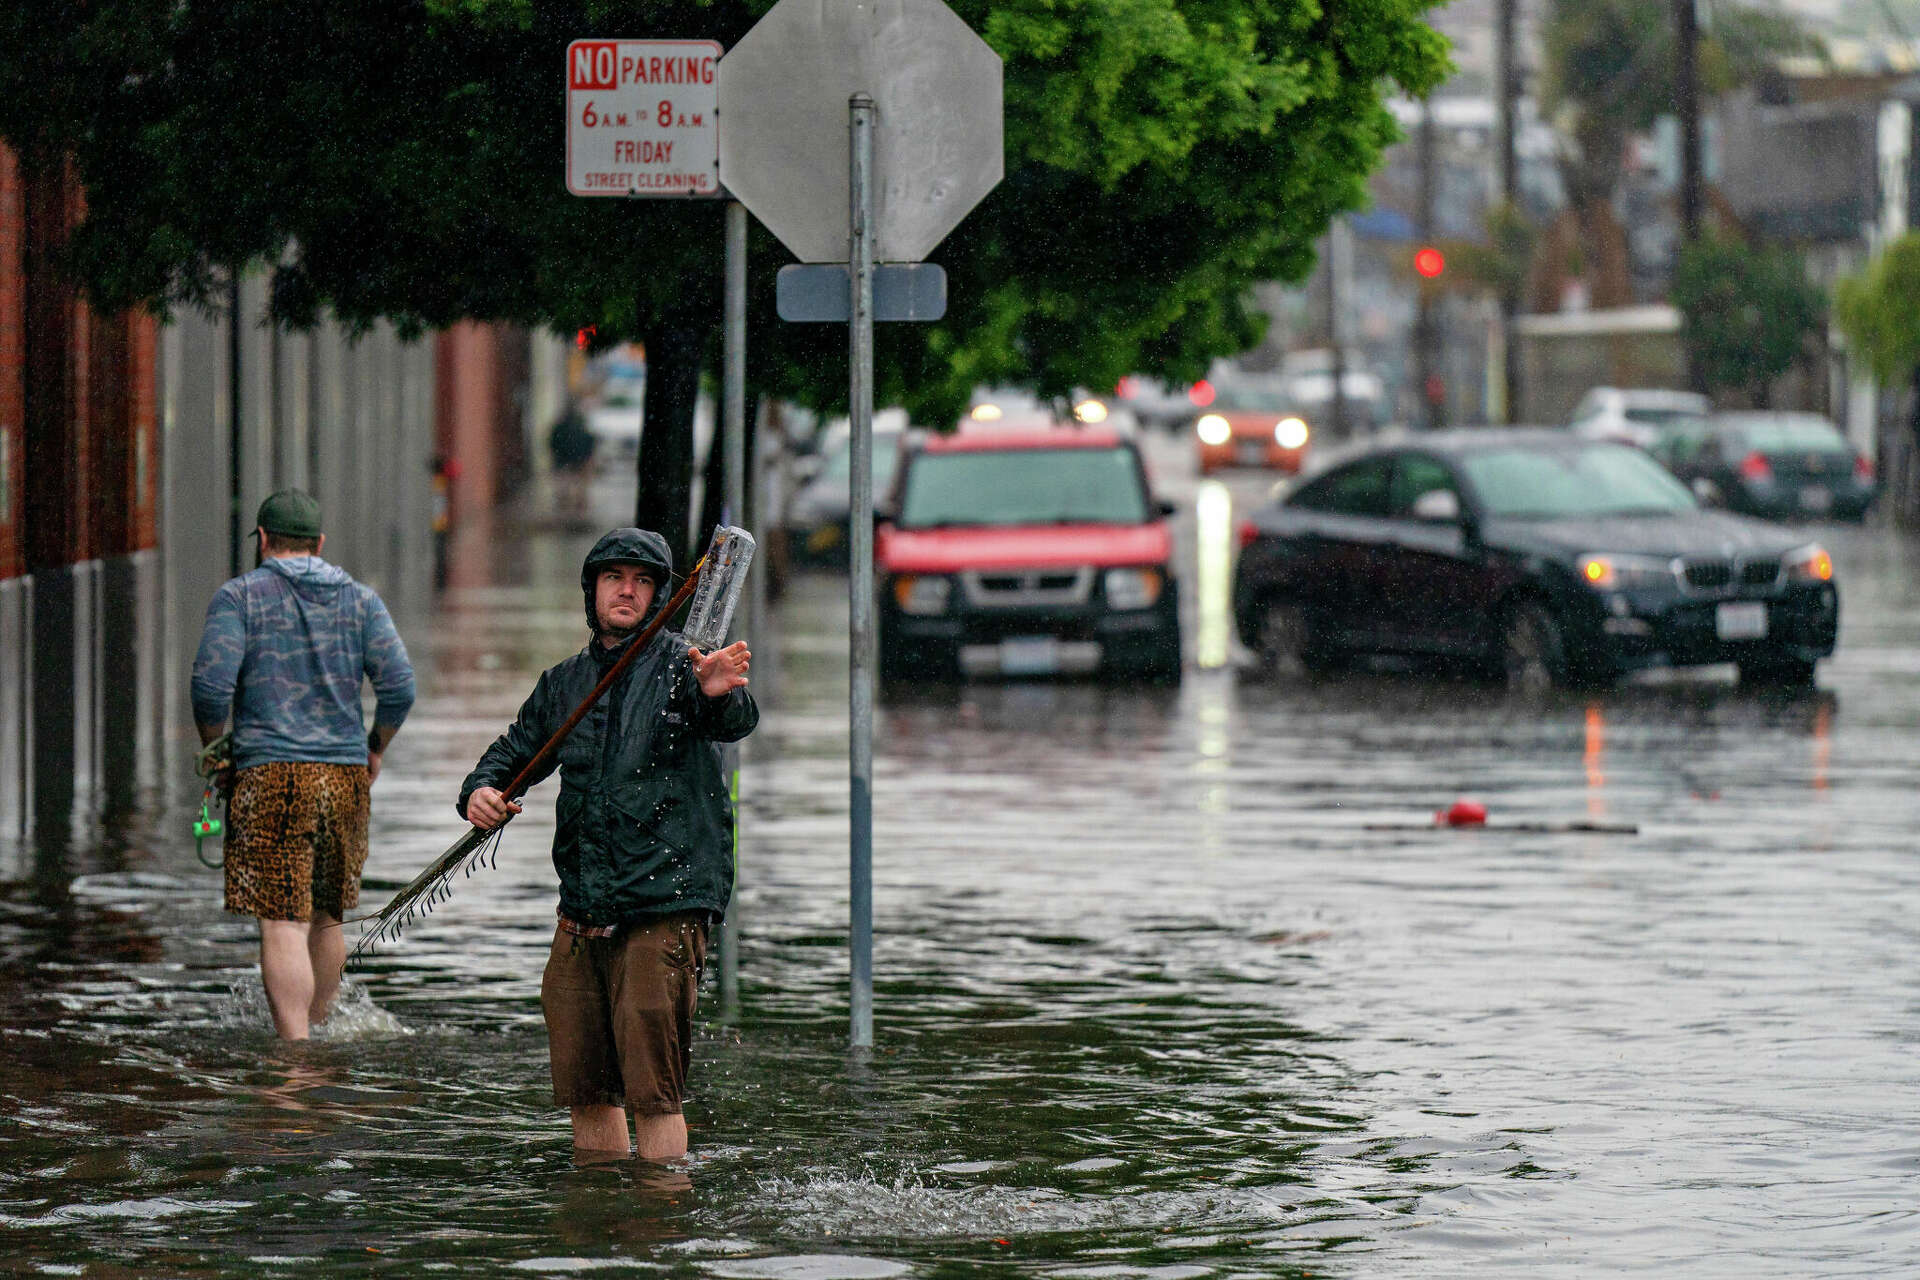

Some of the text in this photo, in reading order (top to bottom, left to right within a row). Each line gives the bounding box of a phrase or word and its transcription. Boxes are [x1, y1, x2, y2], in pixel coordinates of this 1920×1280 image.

[574, 46, 713, 85] NO PARKING
[582, 100, 598, 128] 6
[657, 100, 673, 128] 8
[615, 140, 673, 164] FRIDAY
[584, 172, 707, 188] STREET CLEANING
